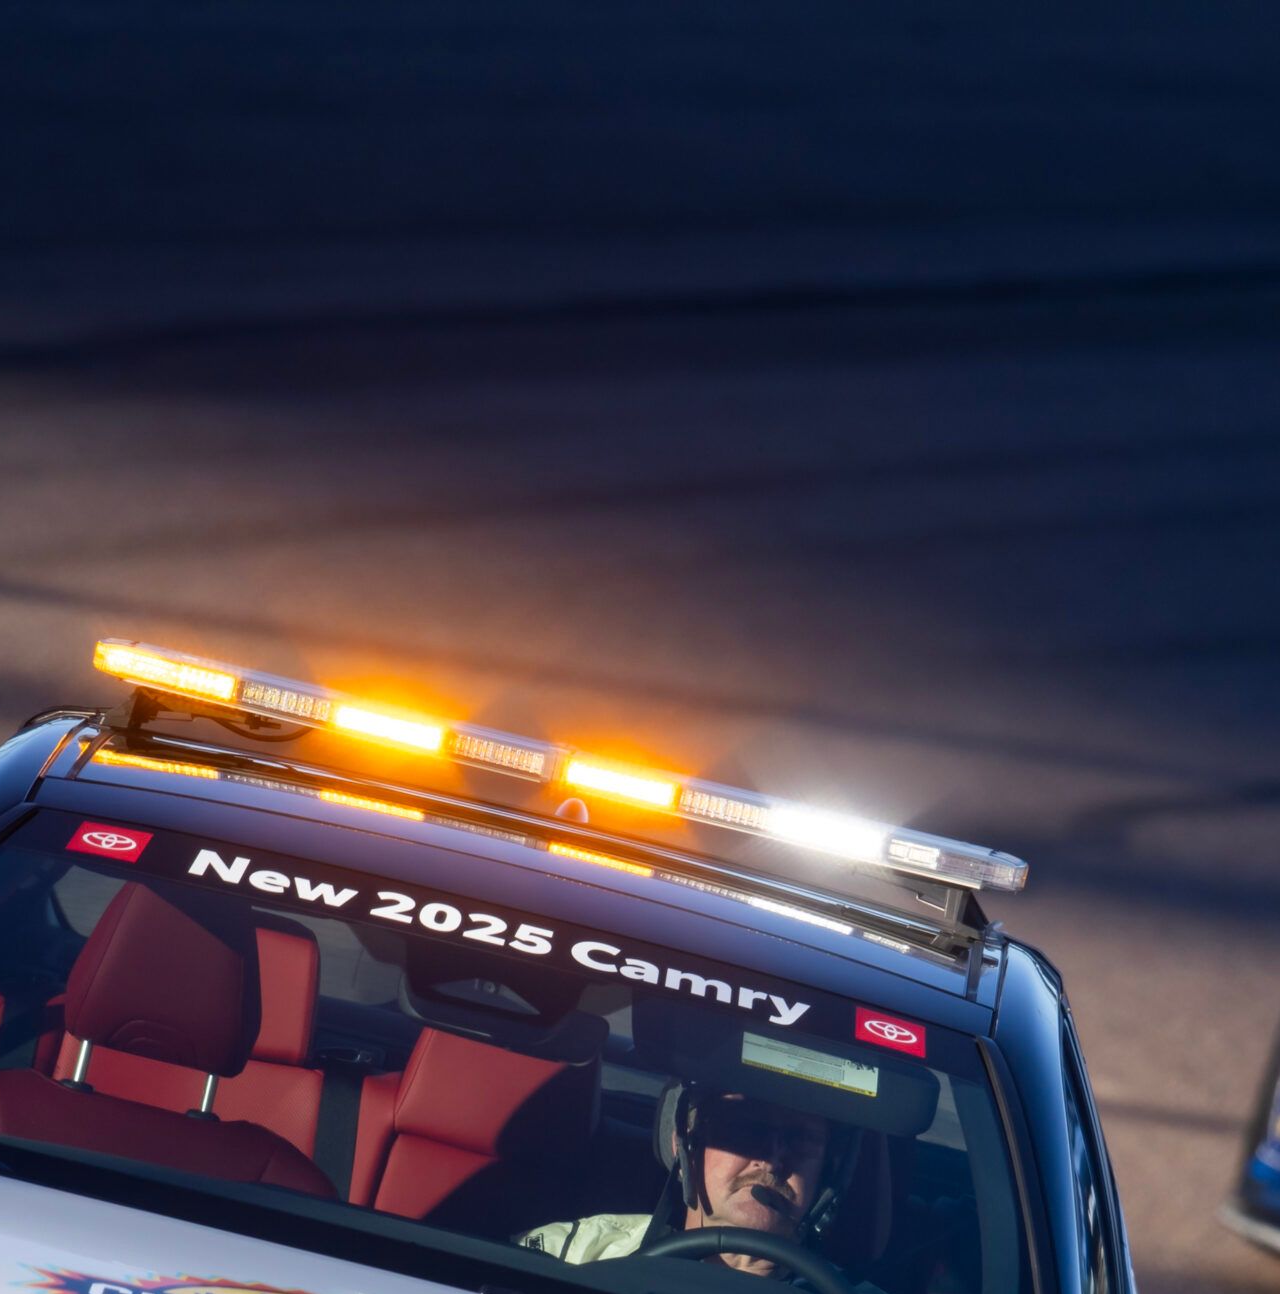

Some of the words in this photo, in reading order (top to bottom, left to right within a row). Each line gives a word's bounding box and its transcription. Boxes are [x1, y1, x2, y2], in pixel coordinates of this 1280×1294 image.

[187, 848, 360, 908] New
[369, 891, 554, 956] 2025
[570, 940, 811, 1026] Camry
